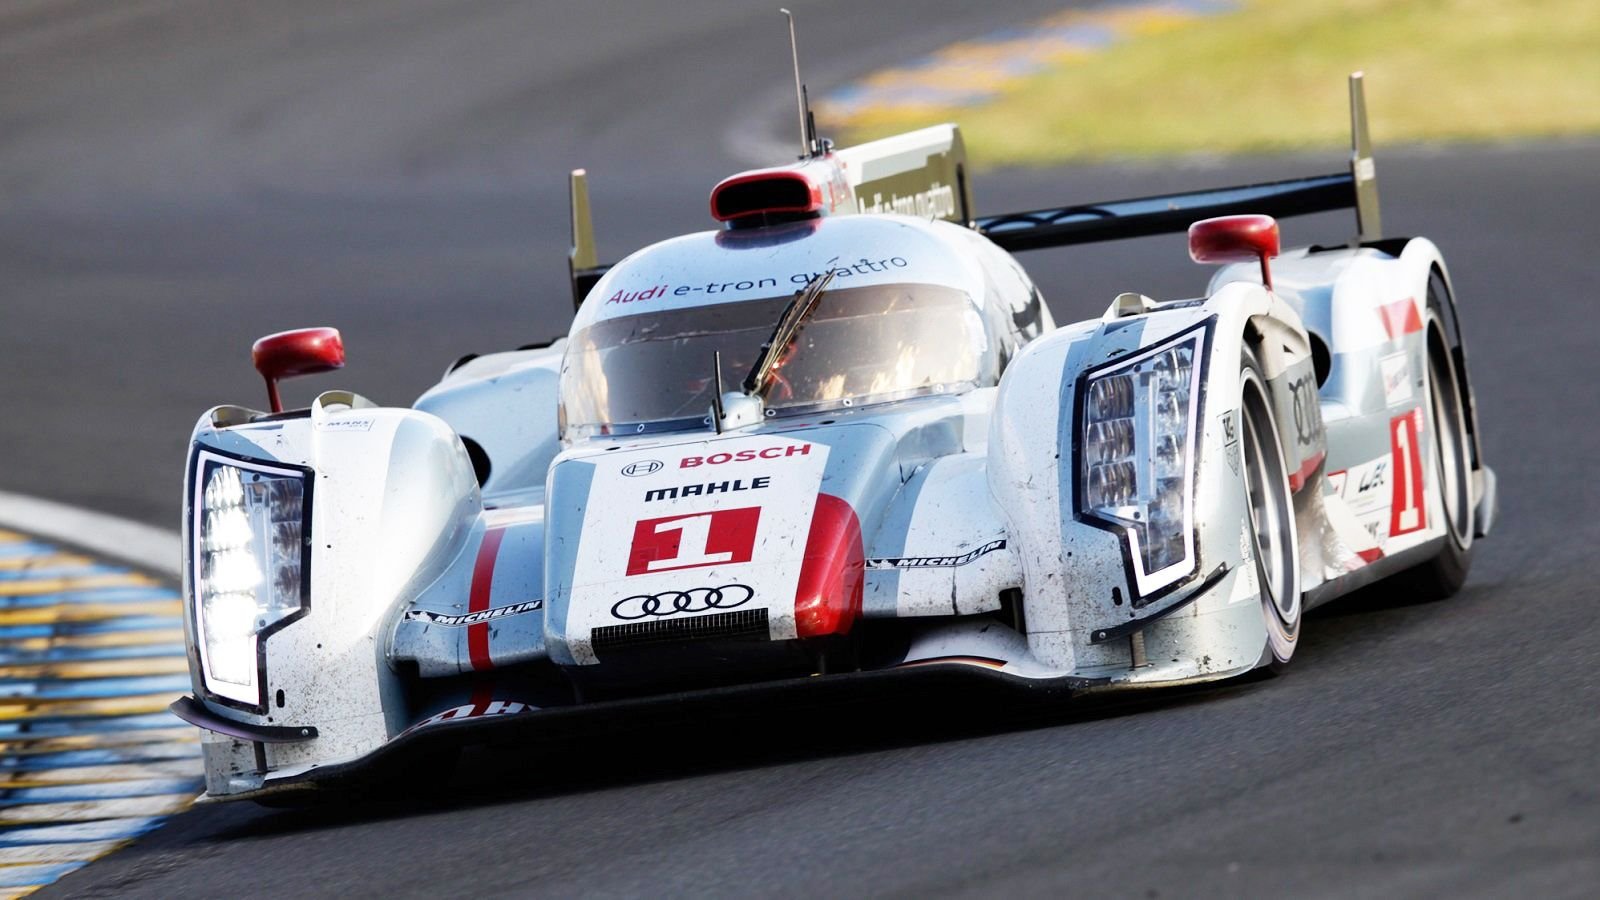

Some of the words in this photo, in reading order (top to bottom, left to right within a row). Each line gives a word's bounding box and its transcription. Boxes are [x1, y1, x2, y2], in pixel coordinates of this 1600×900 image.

[605, 284, 668, 305] Audi
[673, 276, 777, 296] e-tron
[679, 444, 812, 469] BOSCH
[1394, 419, 1419, 530] 1
[644, 476, 771, 502] MAHLE
[646, 513, 733, 571] 1
[896, 540, 1002, 567] MICHELIN
[434, 600, 541, 625] MICHELIN
